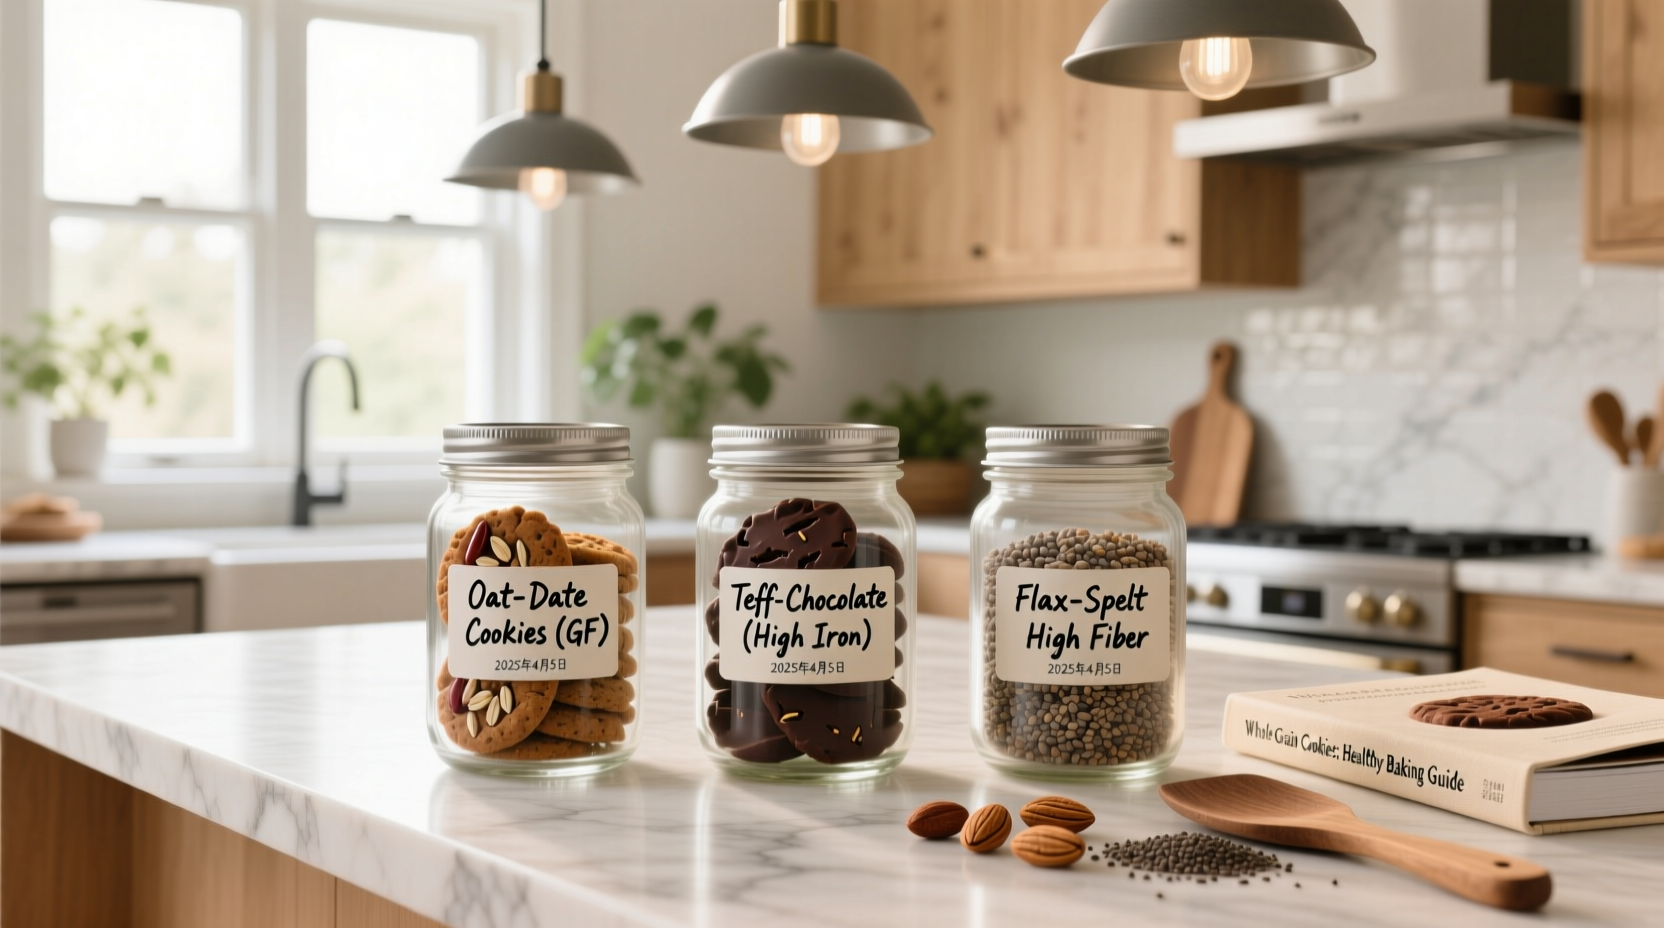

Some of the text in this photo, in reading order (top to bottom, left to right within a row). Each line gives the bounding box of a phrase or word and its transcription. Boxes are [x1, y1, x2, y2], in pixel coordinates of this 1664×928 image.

[469, 579, 588, 610] Oat-Date
[731, 582, 888, 619] Teff-Chocolate
[1016, 583, 1148, 621] Flax-Spelt
[466, 613, 609, 650] Cookies (GF)
[743, 617, 871, 658] (High Iron)
[1027, 621, 1149, 660] High Fiber
[495, 658, 567, 672] 2025年4月5日
[771, 661, 844, 675] 2025年4月5日
[1048, 662, 1120, 676] 2025年4月5日
[1342, 743, 1384, 775] Healthy
[1386, 754, 1424, 787] Baking
[1427, 765, 1465, 792] Guide
